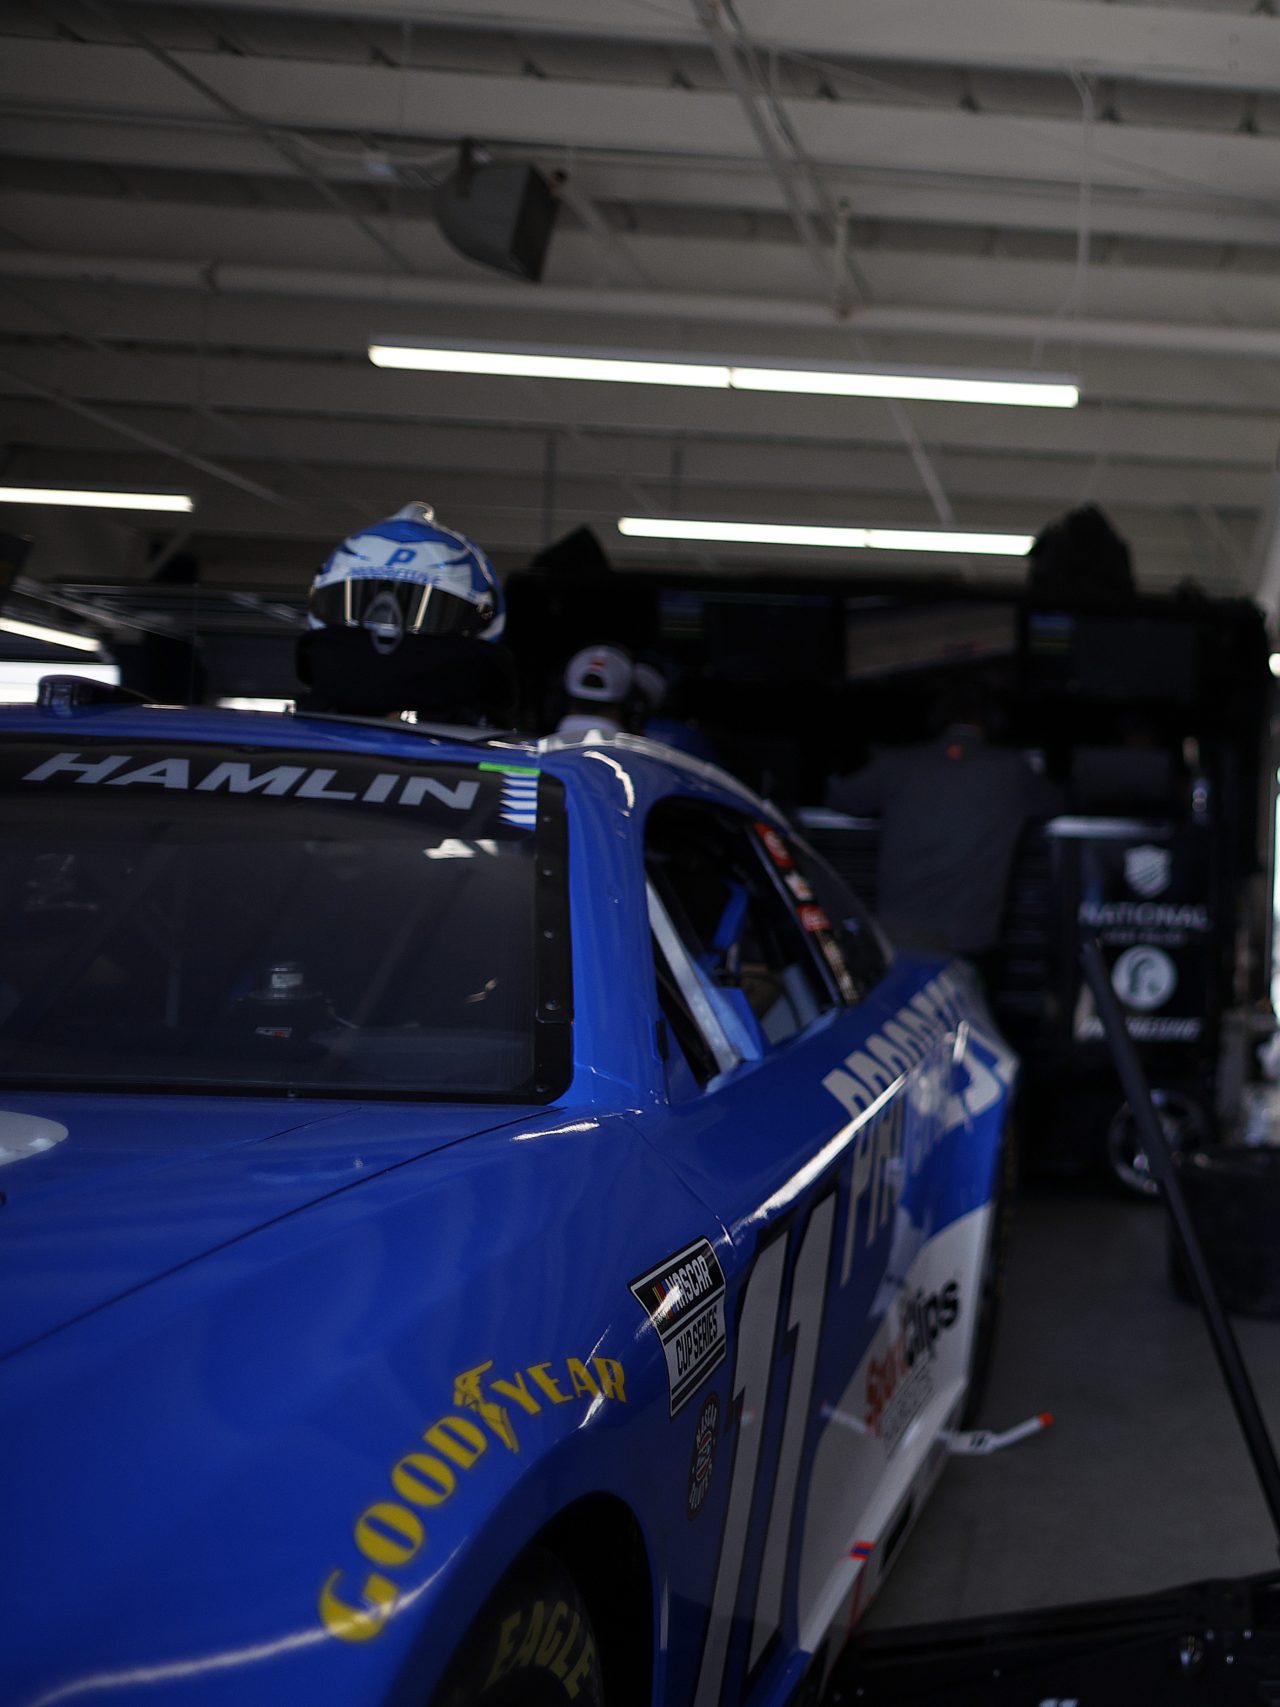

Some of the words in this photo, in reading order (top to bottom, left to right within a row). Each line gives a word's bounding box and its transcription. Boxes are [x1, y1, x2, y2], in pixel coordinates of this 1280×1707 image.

[22, 752, 480, 810] HAMLIN
[665, 1254, 713, 1311] NASCAR
[675, 1334, 693, 1376] CUP
[692, 1304, 718, 1360] SERIES
[319, 1358, 628, 1642] GOODYEAR
[479, 1599, 600, 1700] EAGLE
